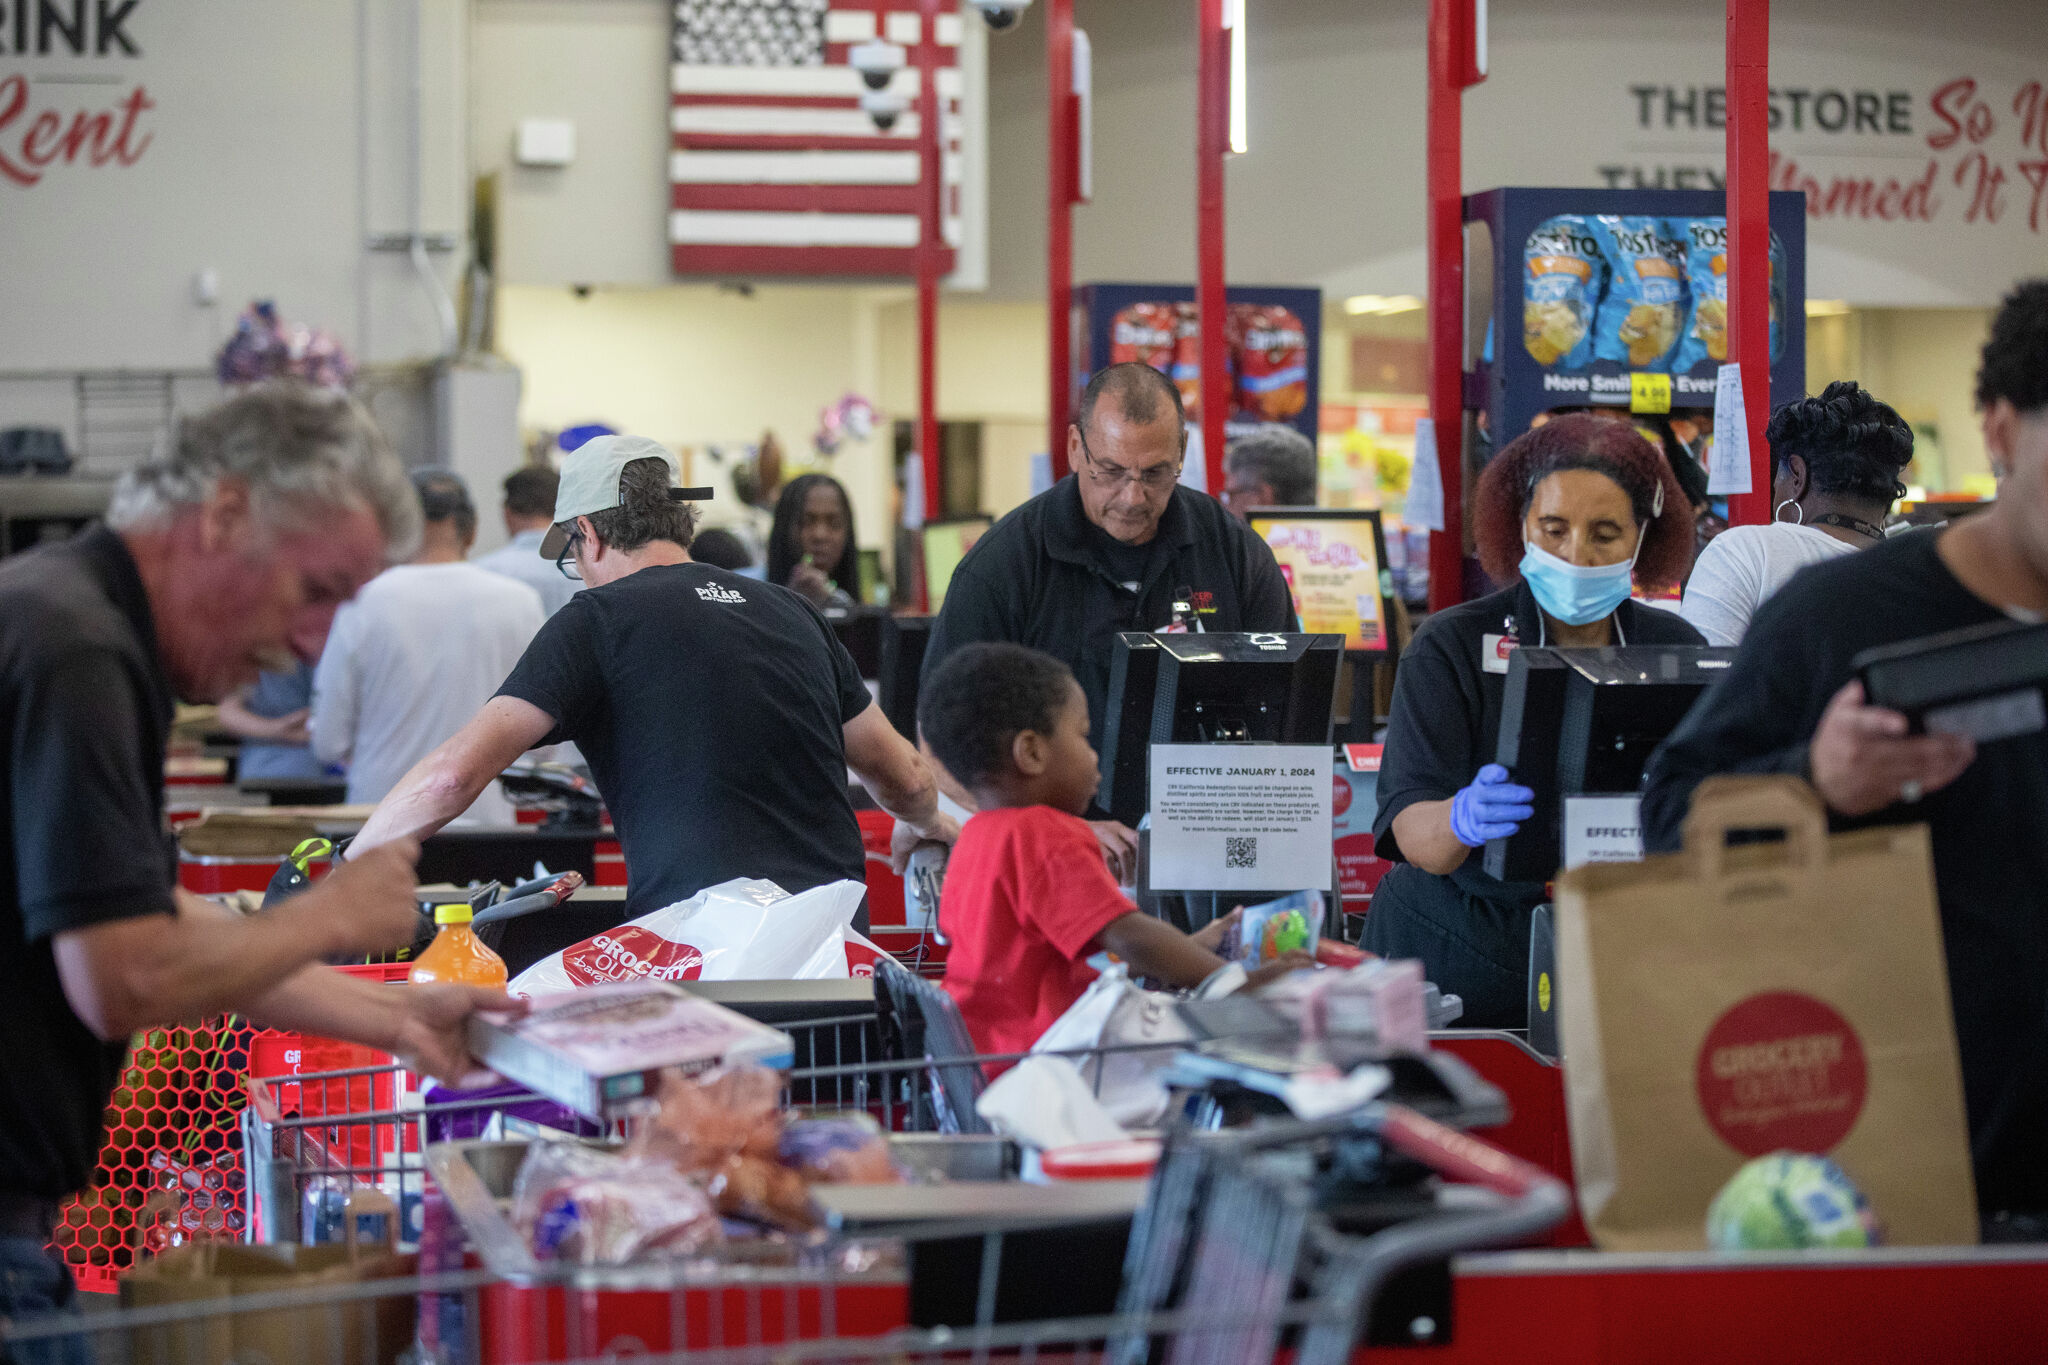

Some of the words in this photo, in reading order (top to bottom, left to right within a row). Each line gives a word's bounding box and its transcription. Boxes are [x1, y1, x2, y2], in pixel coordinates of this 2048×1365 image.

[1630, 86, 1727, 130] THE
[1926, 75, 1995, 149] So
[1544, 374, 1589, 392] More
[1591, 374, 1631, 392] Smil
[1677, 376, 1717, 393] Ever
[695, 587, 743, 600] PIXAR
[1166, 767, 1223, 776] EFFECTIVE
[1226, 767, 1277, 776] JANUARY
[1280, 768, 1288, 778] 1,
[1290, 768, 1316, 777] 2024
[1586, 827, 1642, 838] EFFECTI
[1340, 879, 1368, 892] unity.
[591, 935, 688, 980] GROCERY
